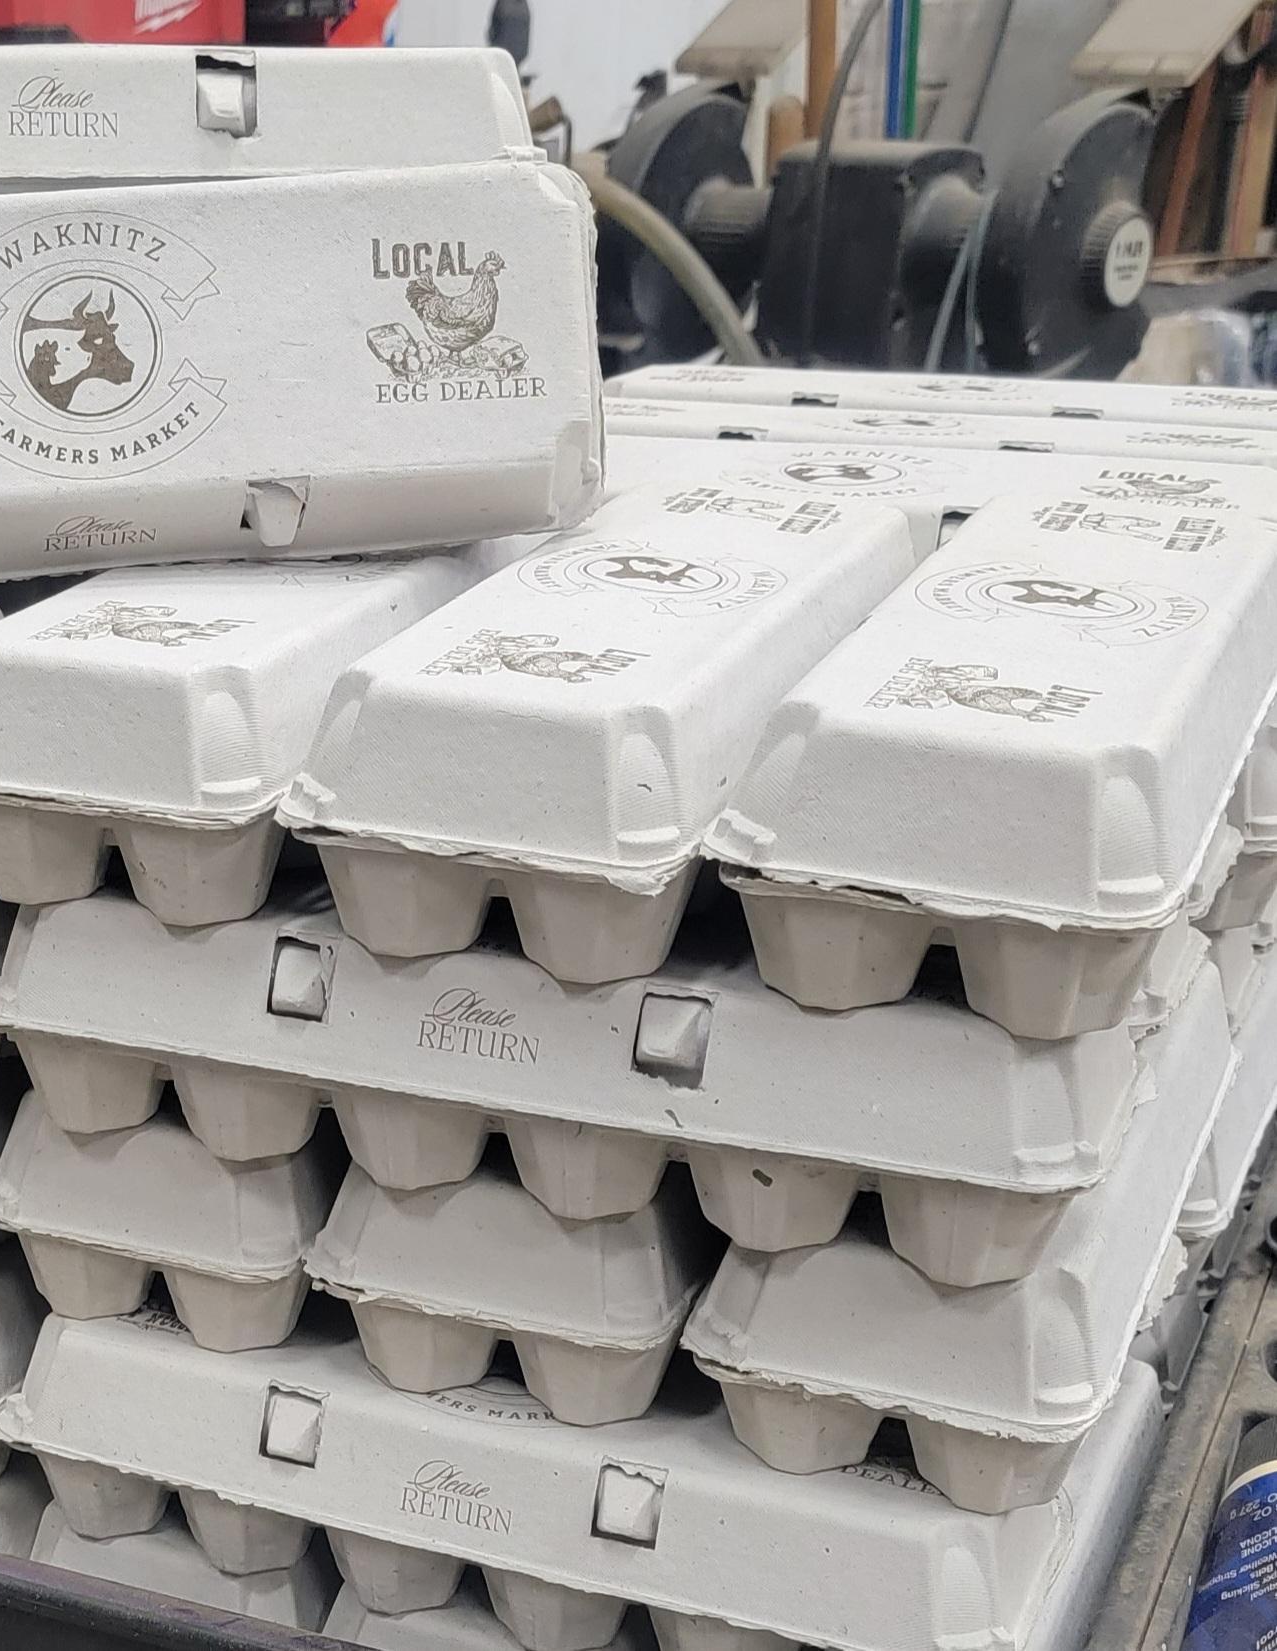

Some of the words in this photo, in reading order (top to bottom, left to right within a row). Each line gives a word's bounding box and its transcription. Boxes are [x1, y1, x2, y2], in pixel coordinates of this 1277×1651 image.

[11, 75, 94, 113] Please
[8, 110, 118, 138] RETURN
[372, 238, 474, 279] LOCAL
[375, 381, 430, 404] EGG
[439, 376, 548, 402] DEALER
[111, 401, 200, 462] MARKET
[1098, 469, 1192, 482] LOCAL
[43, 528, 157, 552] RETURN
[48, 514, 133, 539] Please
[425, 987, 516, 1028] Please
[416, 1019, 540, 1064] RETURN
[406, 1459, 491, 1499] Please
[841, 1466, 944, 1496] DEALE
[399, 1486, 513, 1535] RETURN
